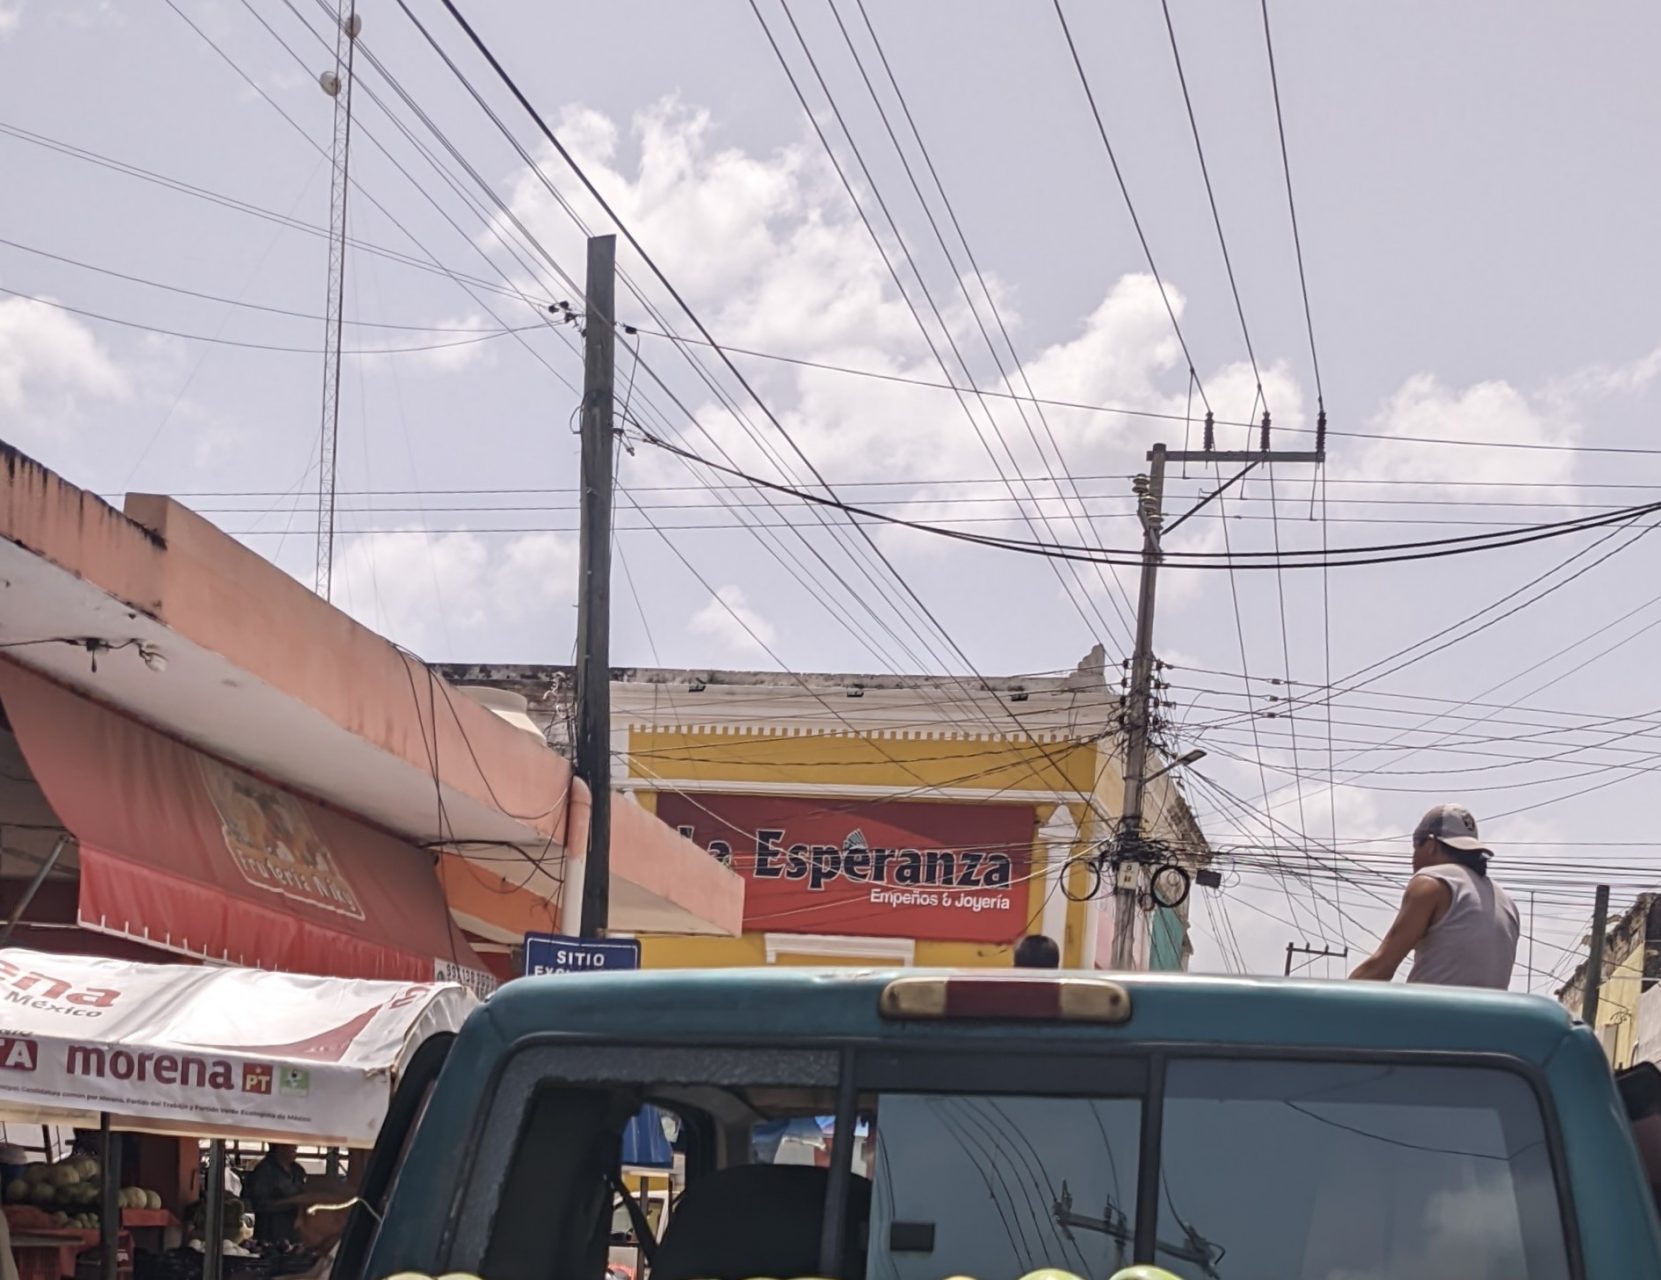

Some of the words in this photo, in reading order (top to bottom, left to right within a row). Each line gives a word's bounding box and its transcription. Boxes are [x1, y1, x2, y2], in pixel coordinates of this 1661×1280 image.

[753, 828, 1012, 891] Esperanza
[870, 888, 939, 908] Empeños
[942, 893, 951, 907] &
[954, 893, 1010, 912] Joyería
[557, 950, 605, 967] SITIO
[4, 990, 103, 1018] México
[66, 1044, 235, 1091] morena
[246, 1073, 271, 1093] PT
